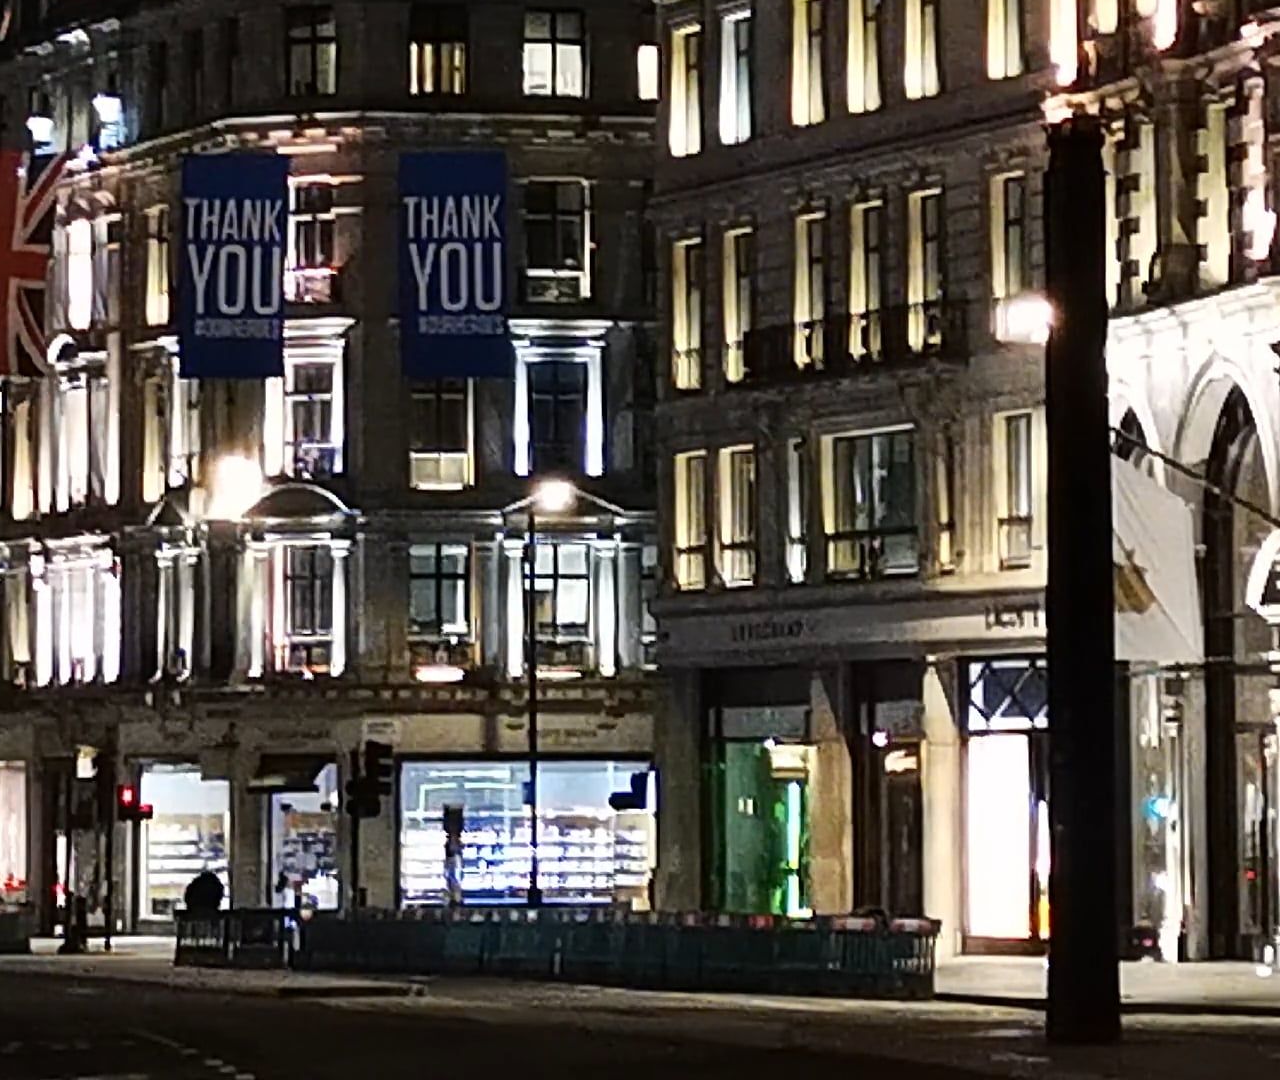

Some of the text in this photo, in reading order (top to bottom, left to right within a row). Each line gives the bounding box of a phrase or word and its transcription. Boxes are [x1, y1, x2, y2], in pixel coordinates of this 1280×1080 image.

[183, 197, 283, 242] THANK
[403, 193, 501, 240] THANK
[187, 243, 281, 316] YOU
[407, 241, 502, 312] YOU
